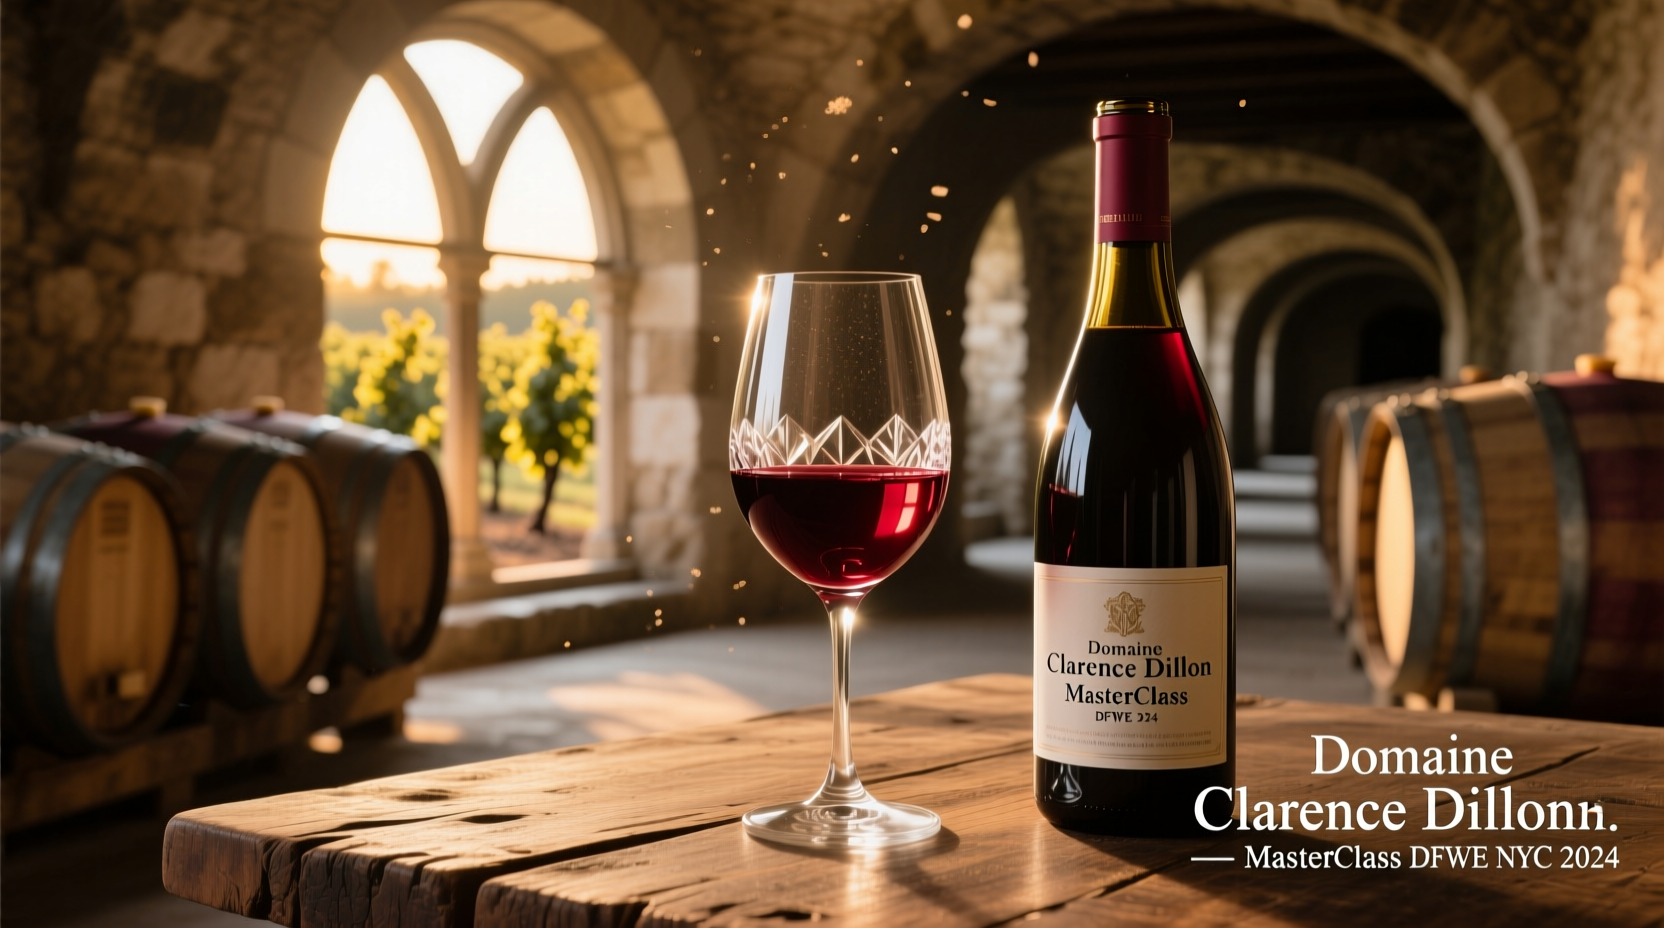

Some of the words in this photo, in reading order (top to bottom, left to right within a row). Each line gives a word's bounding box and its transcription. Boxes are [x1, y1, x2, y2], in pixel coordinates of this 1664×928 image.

[1088, 640, 1163, 656] Domaine
[1047, 652, 1137, 678] Clarence
[1144, 655, 1212, 679] Dillon
[1064, 682, 1189, 706] MasterClass
[1095, 710, 1133, 723] DFWE
